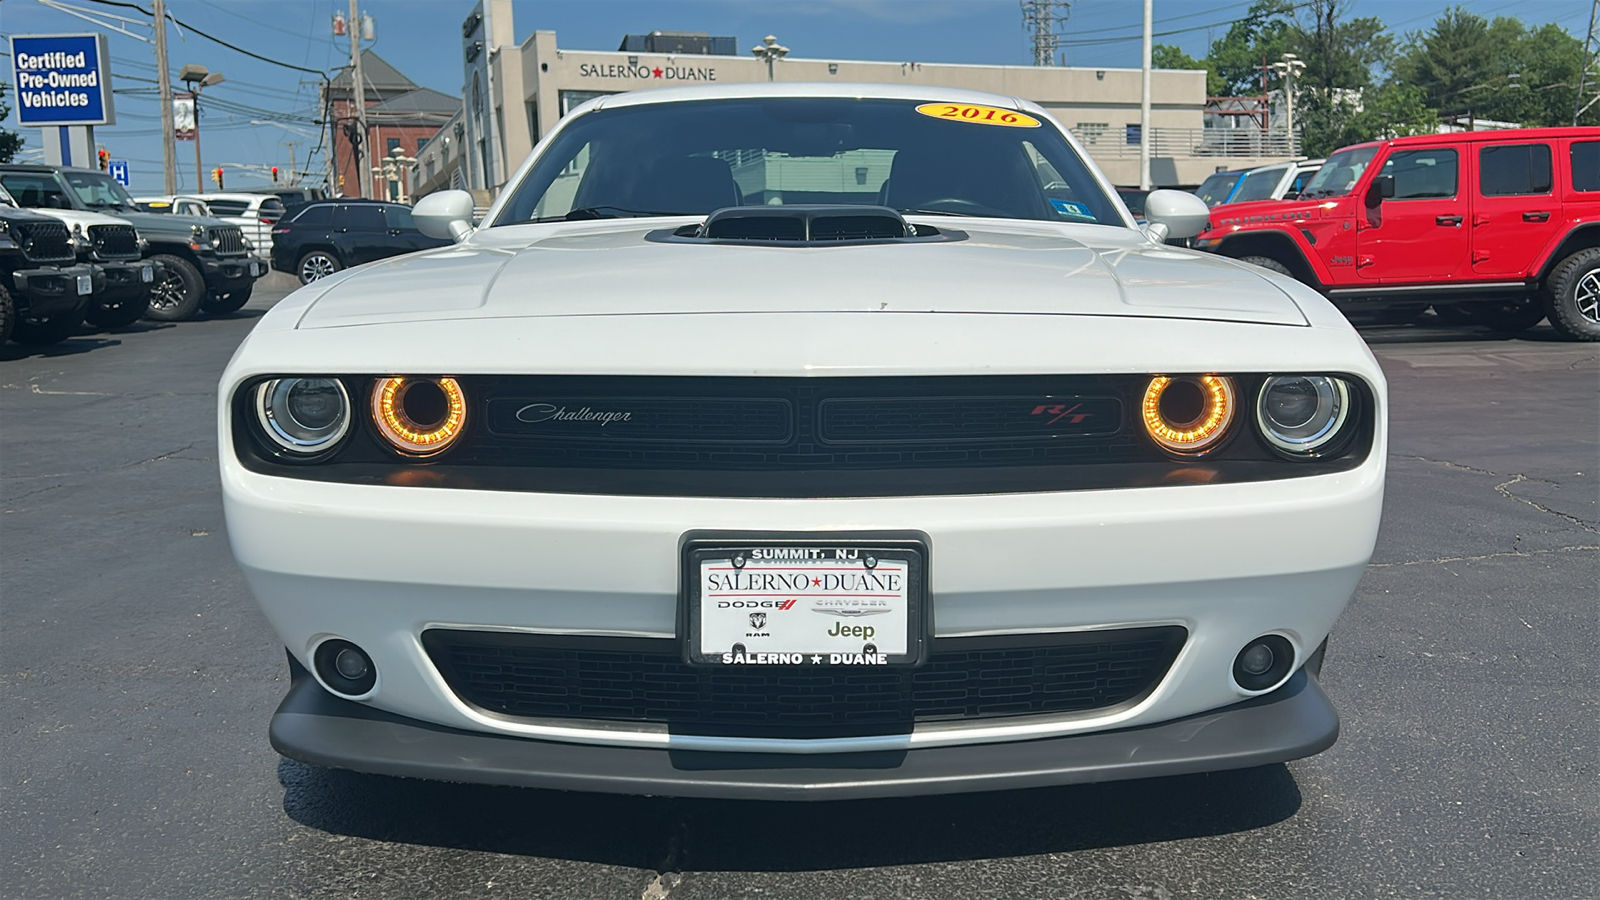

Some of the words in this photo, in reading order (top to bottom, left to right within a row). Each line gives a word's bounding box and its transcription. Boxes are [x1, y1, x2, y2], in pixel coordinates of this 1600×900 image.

[17, 51, 85, 69] Certified
[19, 70, 97, 89] Pre-Owned
[580, 64, 650, 79] SALERNO
[665, 66, 717, 81] DUANE
[22, 91, 88, 108] Vehicles
[940, 106, 1018, 124] 2016
[113, 165, 125, 180] H
[516, 403, 631, 426] Challenger
[1030, 403, 1093, 425] R/T
[752, 549, 826, 560] SUMMIT,
[835, 549, 859, 560] NJ
[708, 573, 810, 591] SALERNO
[823, 573, 901, 591] DUANE
[717, 601, 787, 609] DODGE
[815, 599, 887, 607] CHRYSLER
[828, 622, 875, 641] Jeep
[722, 653, 803, 665] SALERNO
[830, 653, 888, 665] DUANE
